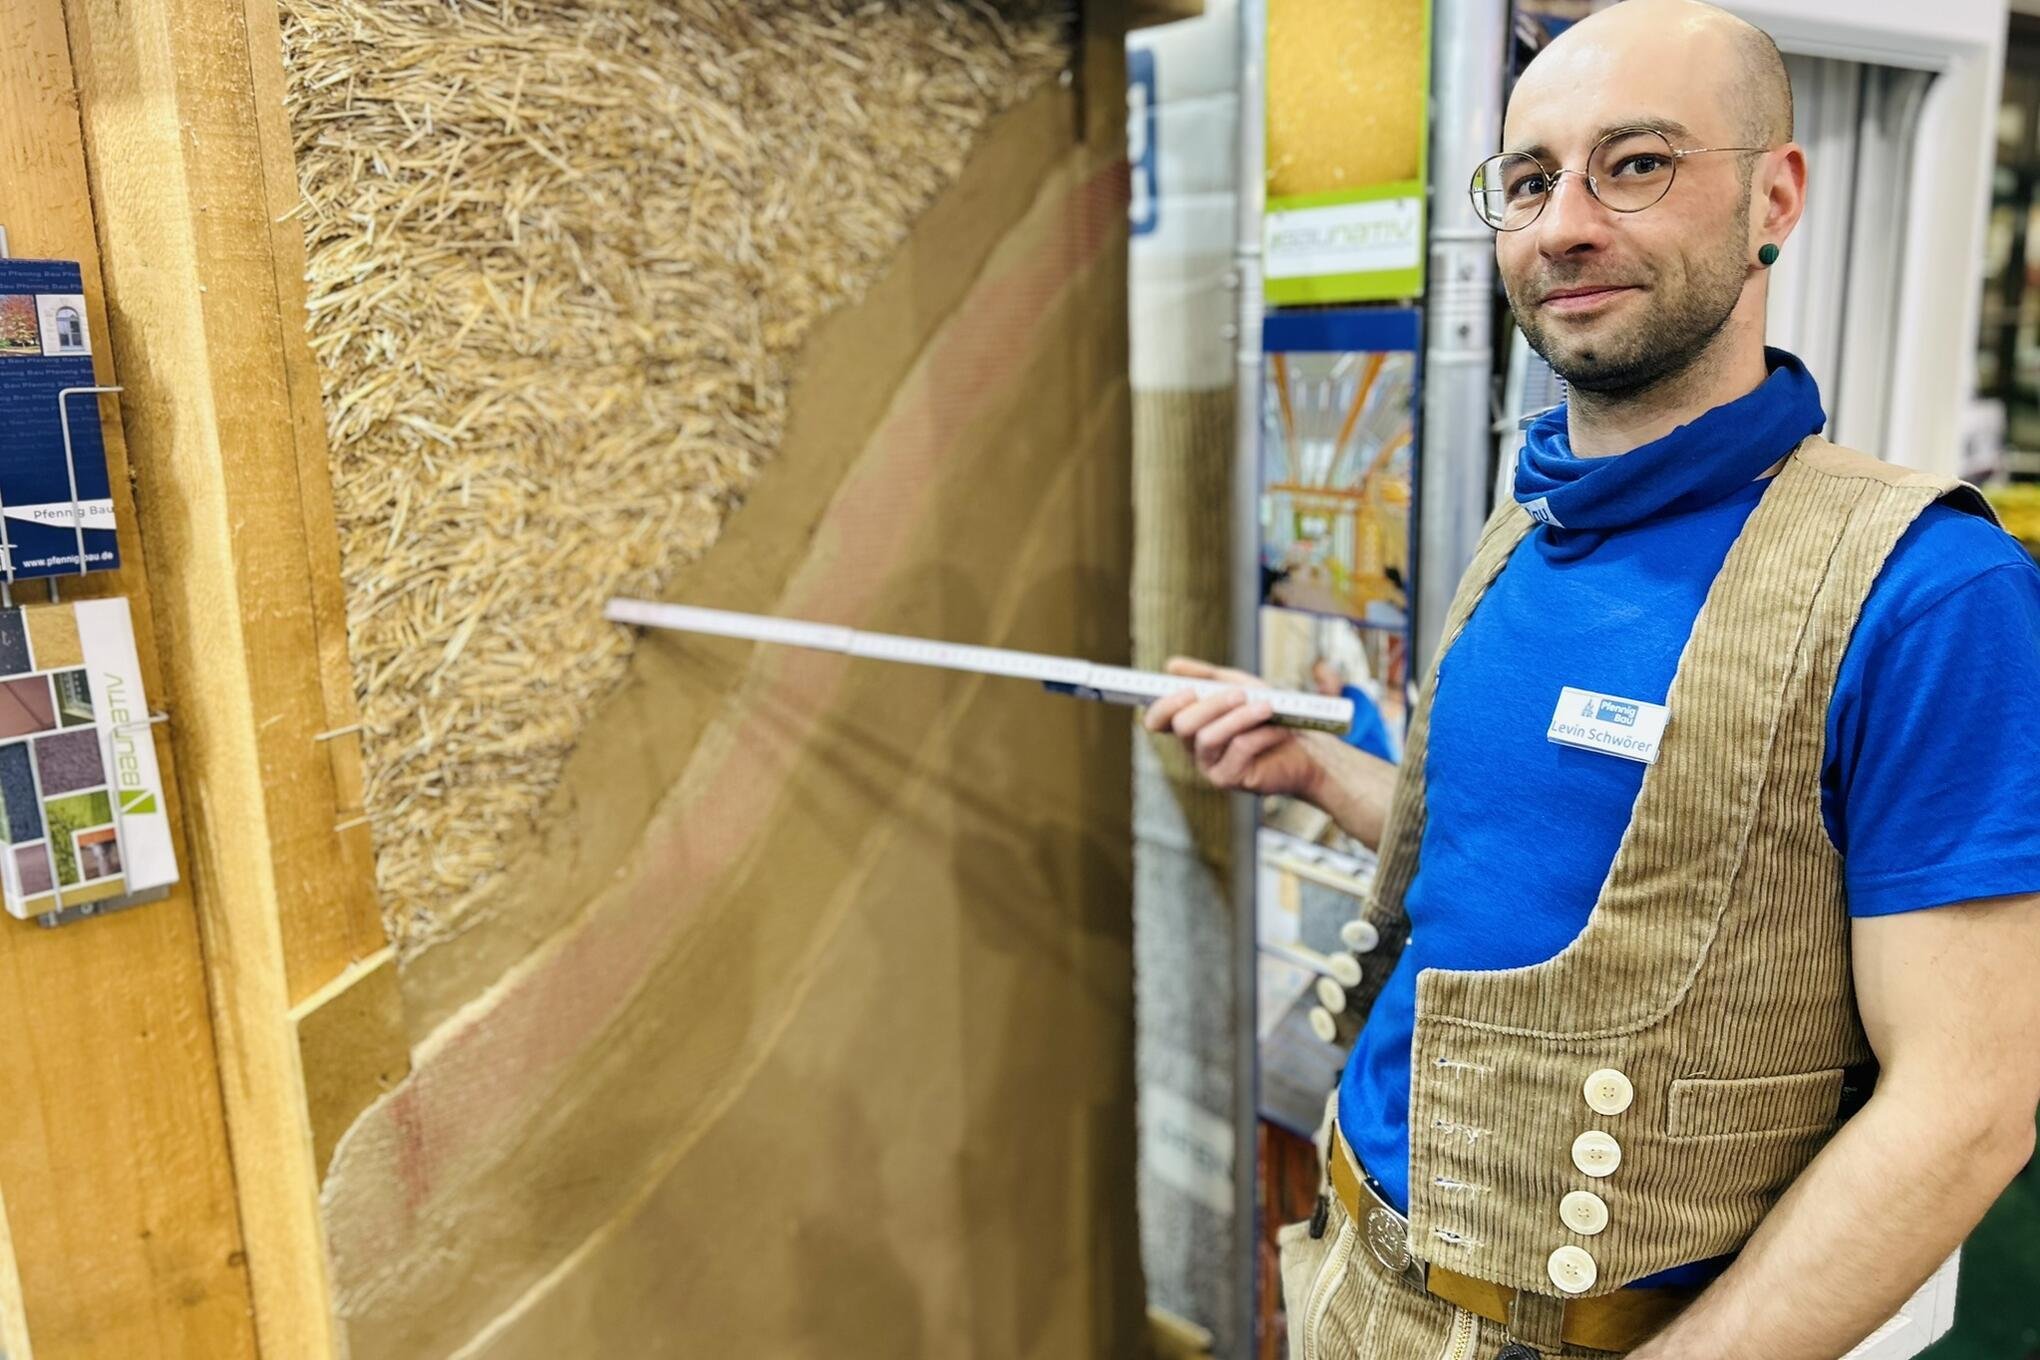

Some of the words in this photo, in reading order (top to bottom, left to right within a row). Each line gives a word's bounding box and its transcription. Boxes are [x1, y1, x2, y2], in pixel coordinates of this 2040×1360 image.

[34, 504, 85, 519] Pfenng
[89, 505, 116, 515] Bau
[1600, 701, 1636, 717] Pfennig
[1551, 720, 1586, 738] Levin
[1588, 728, 1653, 752] Schwörer
